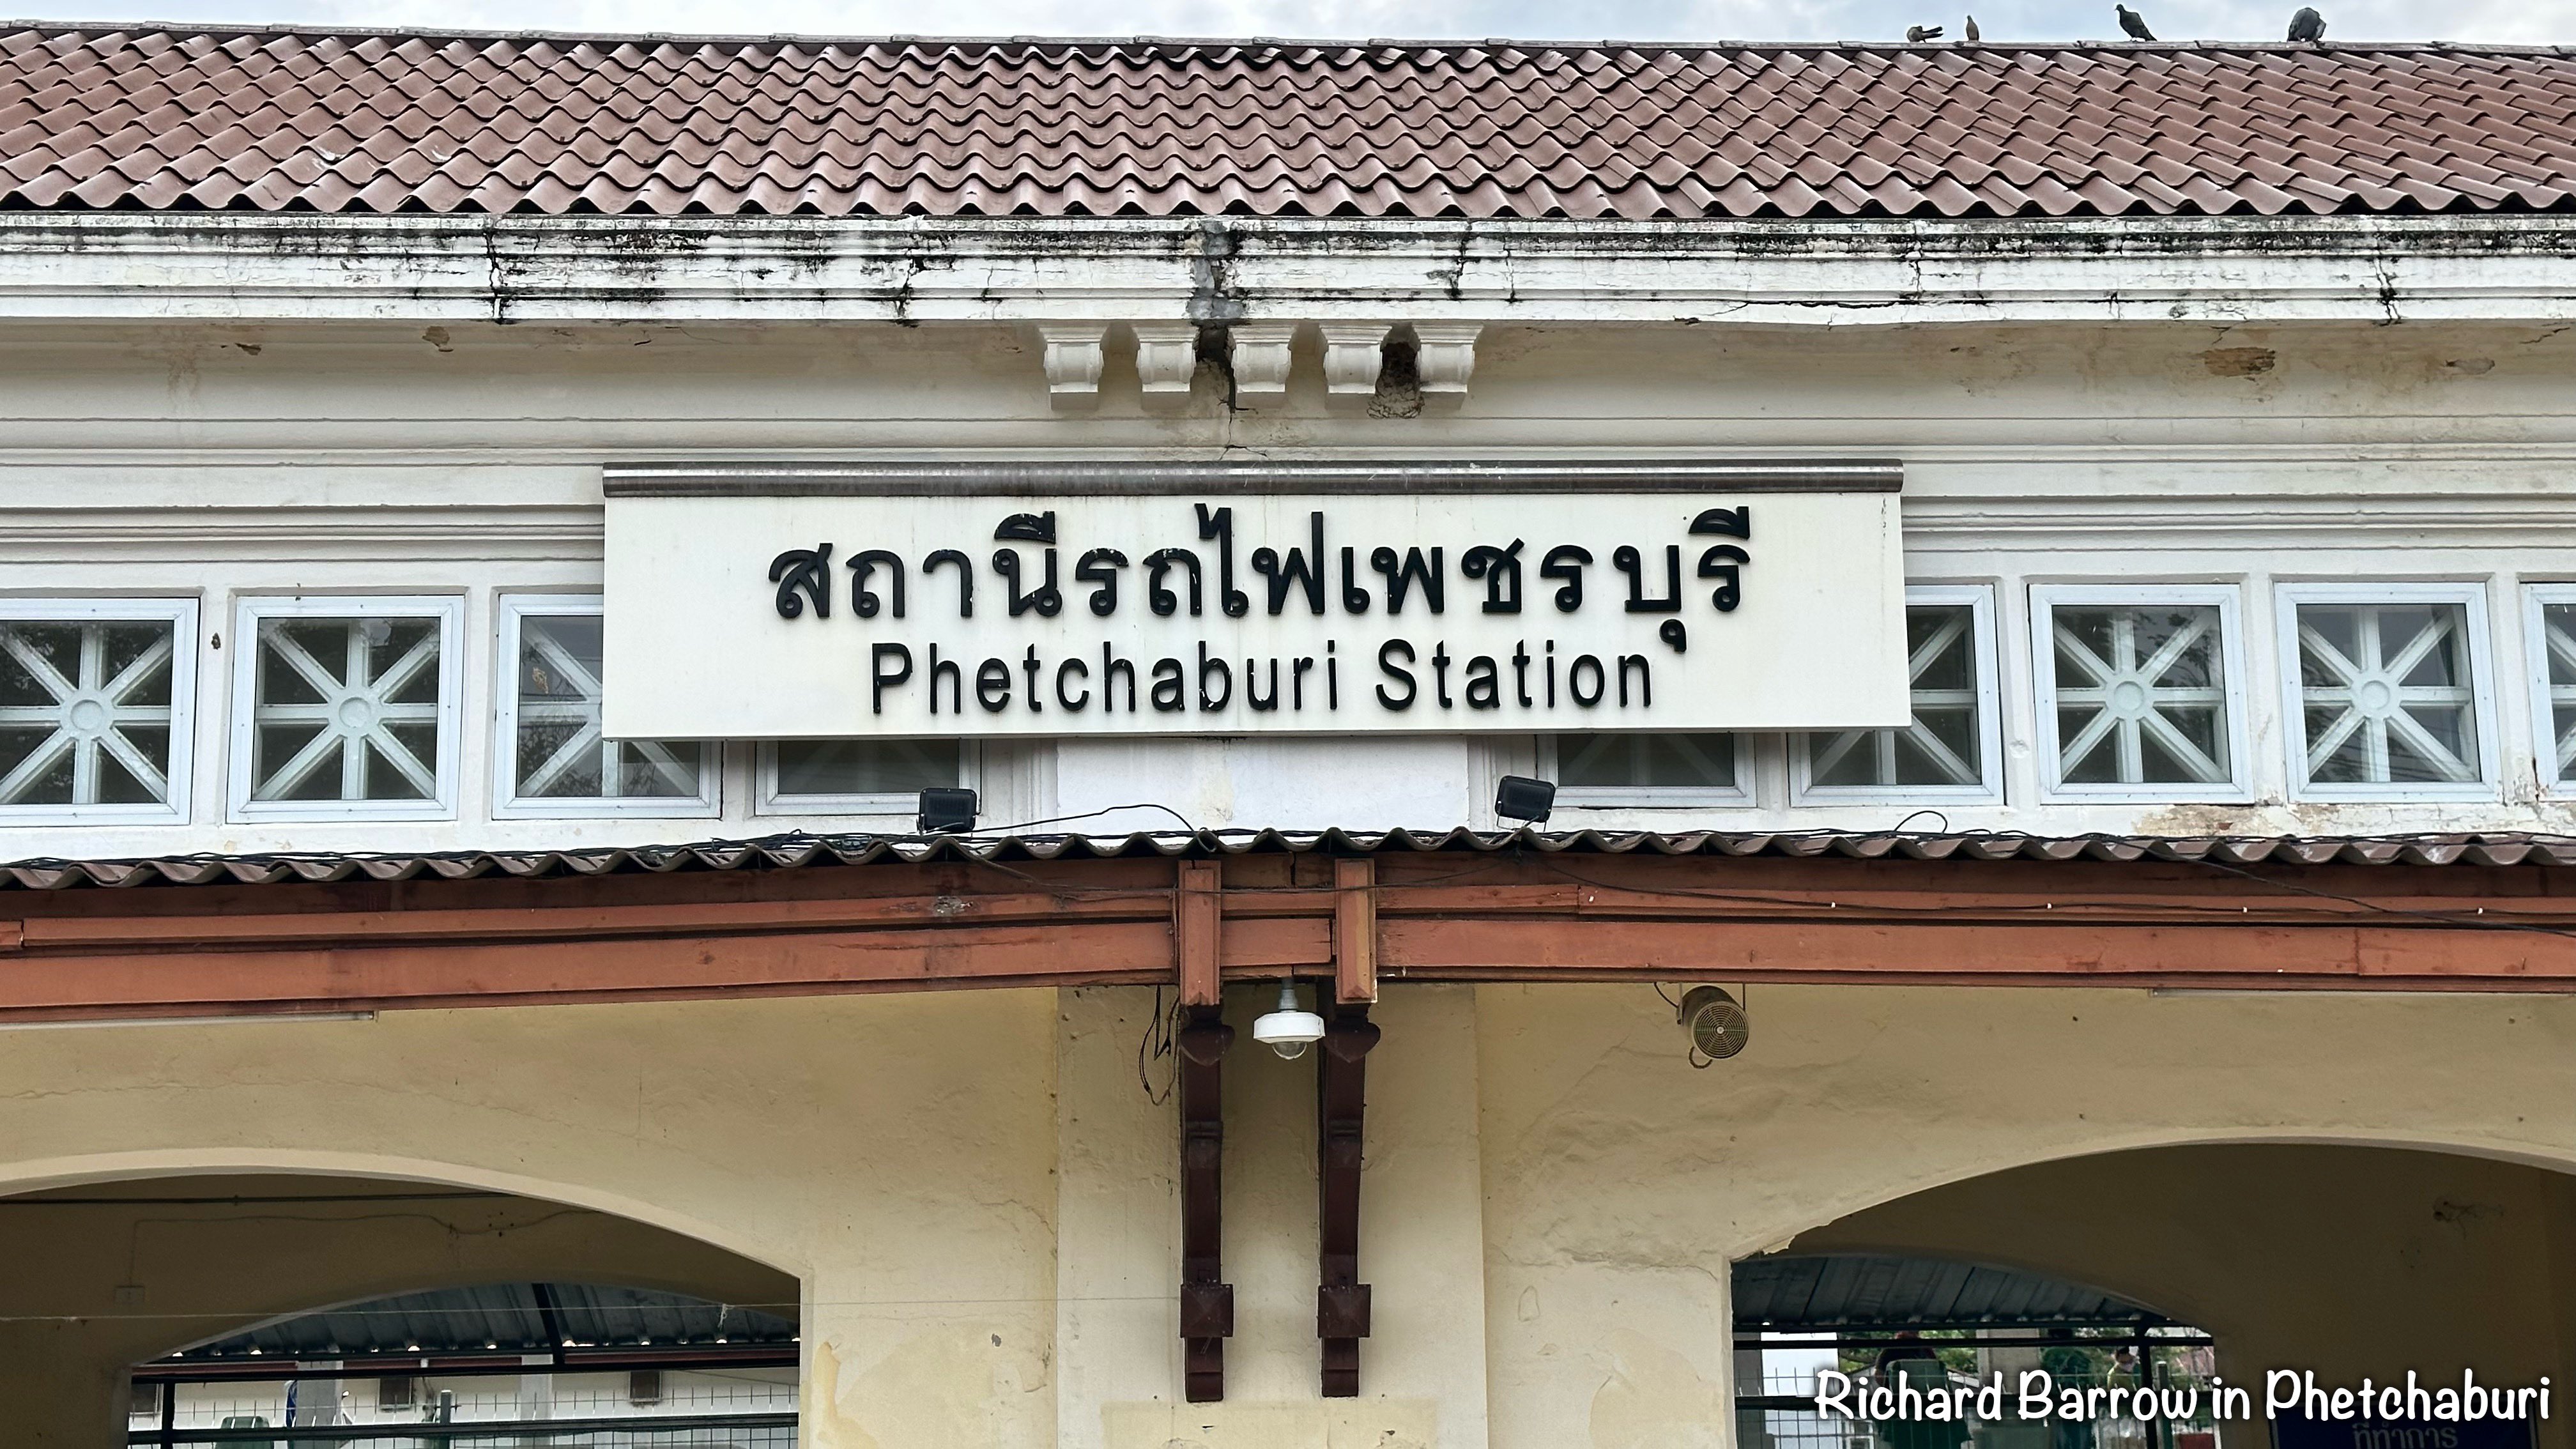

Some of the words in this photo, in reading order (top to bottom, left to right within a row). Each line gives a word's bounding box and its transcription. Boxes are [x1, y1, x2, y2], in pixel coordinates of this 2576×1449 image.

[768, 503, 1751, 655] สถานีรถไฟเพชรบุรี
[871, 640, 1338, 714] Phetchaburi
[1376, 638, 1652, 713] Station
